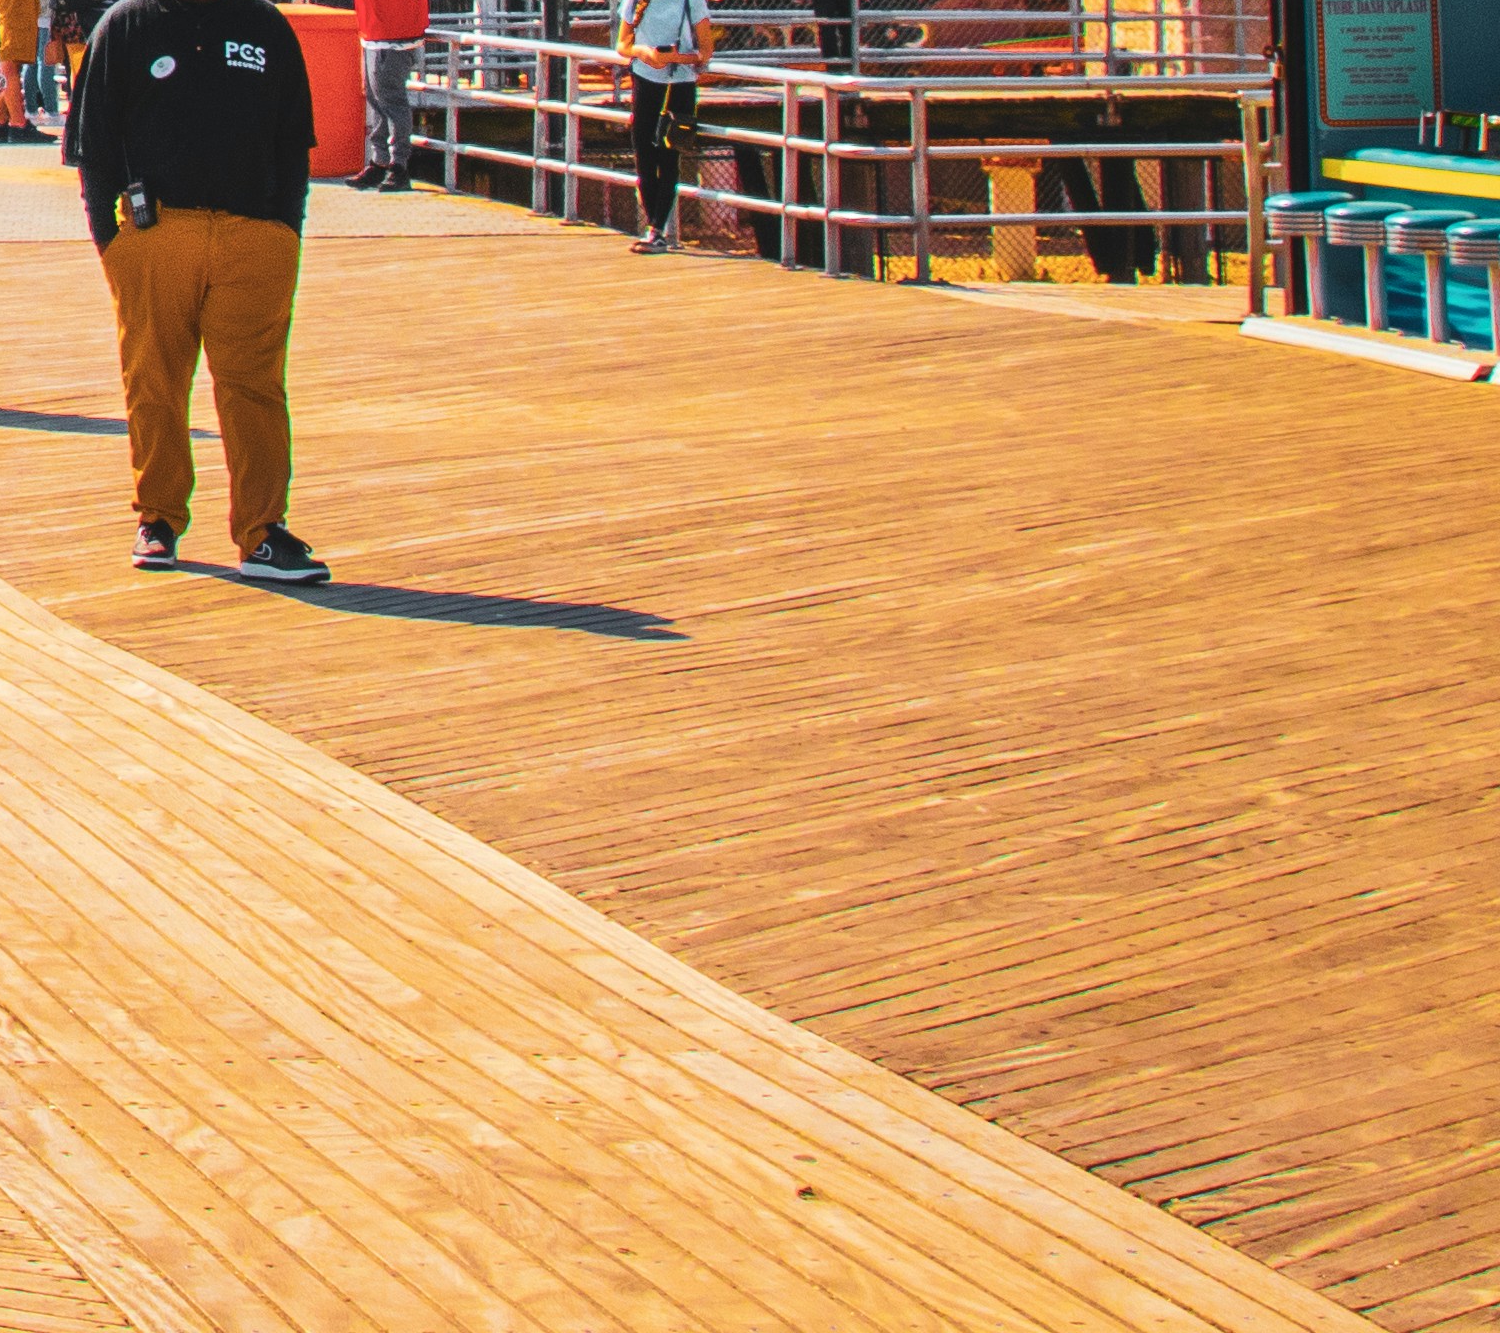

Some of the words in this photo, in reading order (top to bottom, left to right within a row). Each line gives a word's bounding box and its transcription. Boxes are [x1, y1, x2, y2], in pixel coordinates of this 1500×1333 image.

[1356, 0, 1385, 14] DASH
[1387, 0, 1428, 13] SPLASH
[225, 41, 266, 66] PCS
[226, 59, 265, 73] SECURITY
